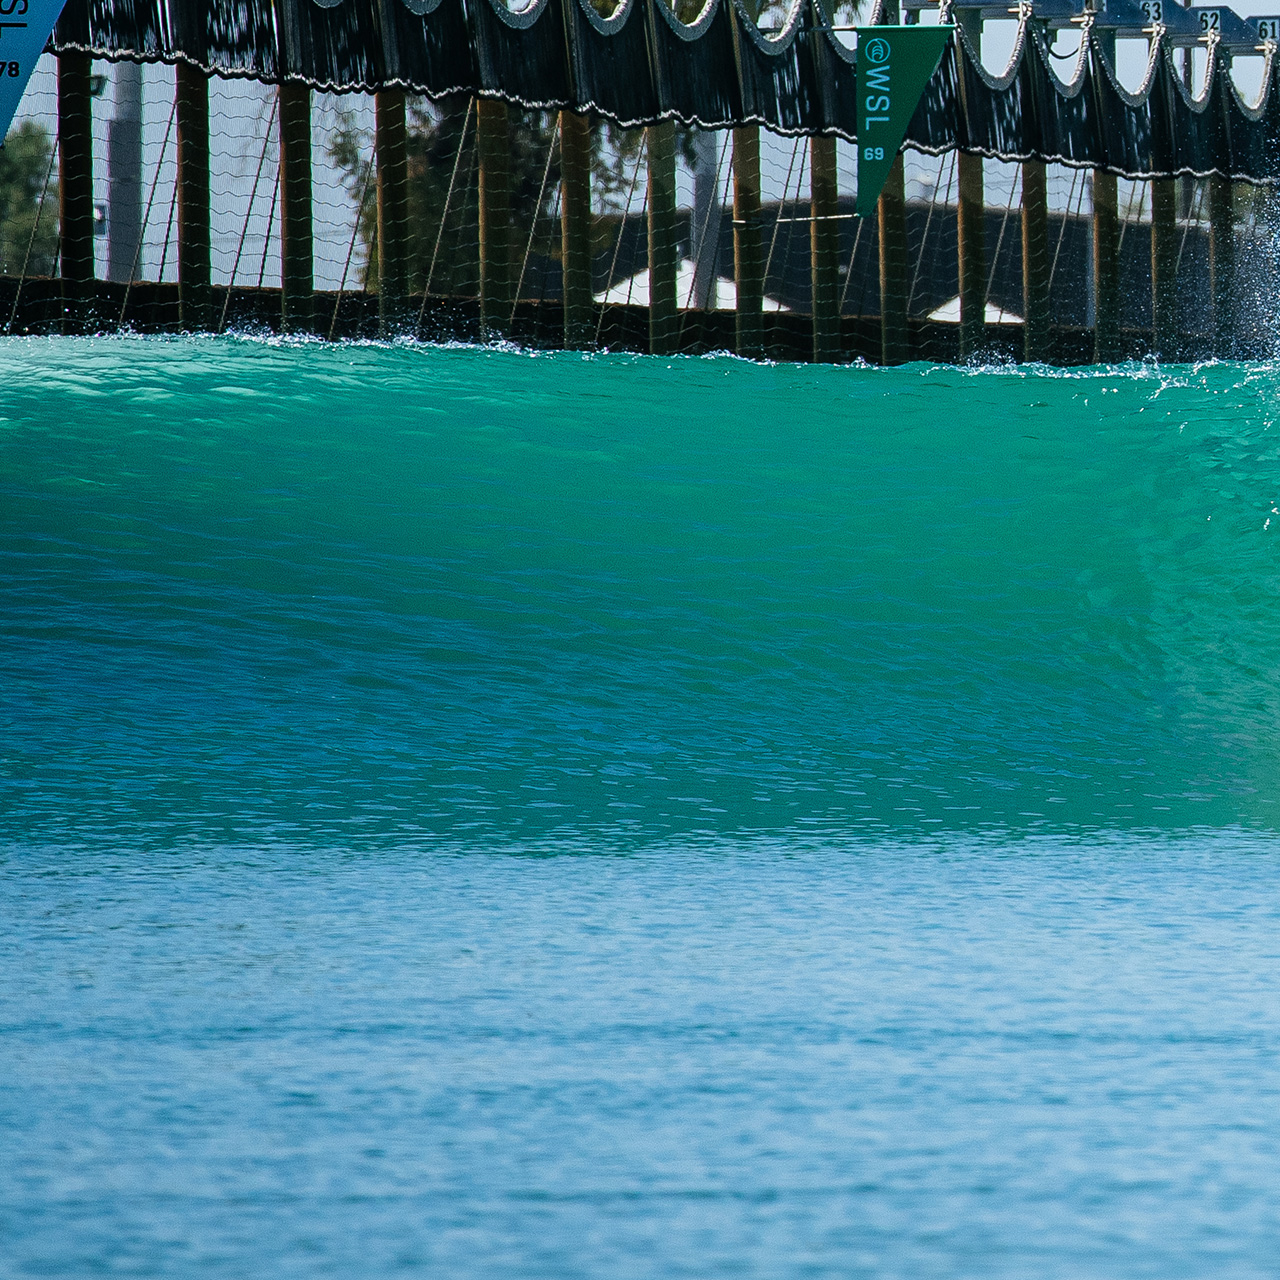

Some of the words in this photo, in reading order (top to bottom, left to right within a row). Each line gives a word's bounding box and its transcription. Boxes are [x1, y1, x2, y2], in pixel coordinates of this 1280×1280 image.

[1200, 12, 1219, 31] 62
[1258, 21, 1277, 39] 61
[865, 65, 891, 131] WSL
[863, 147, 884, 160] 69
